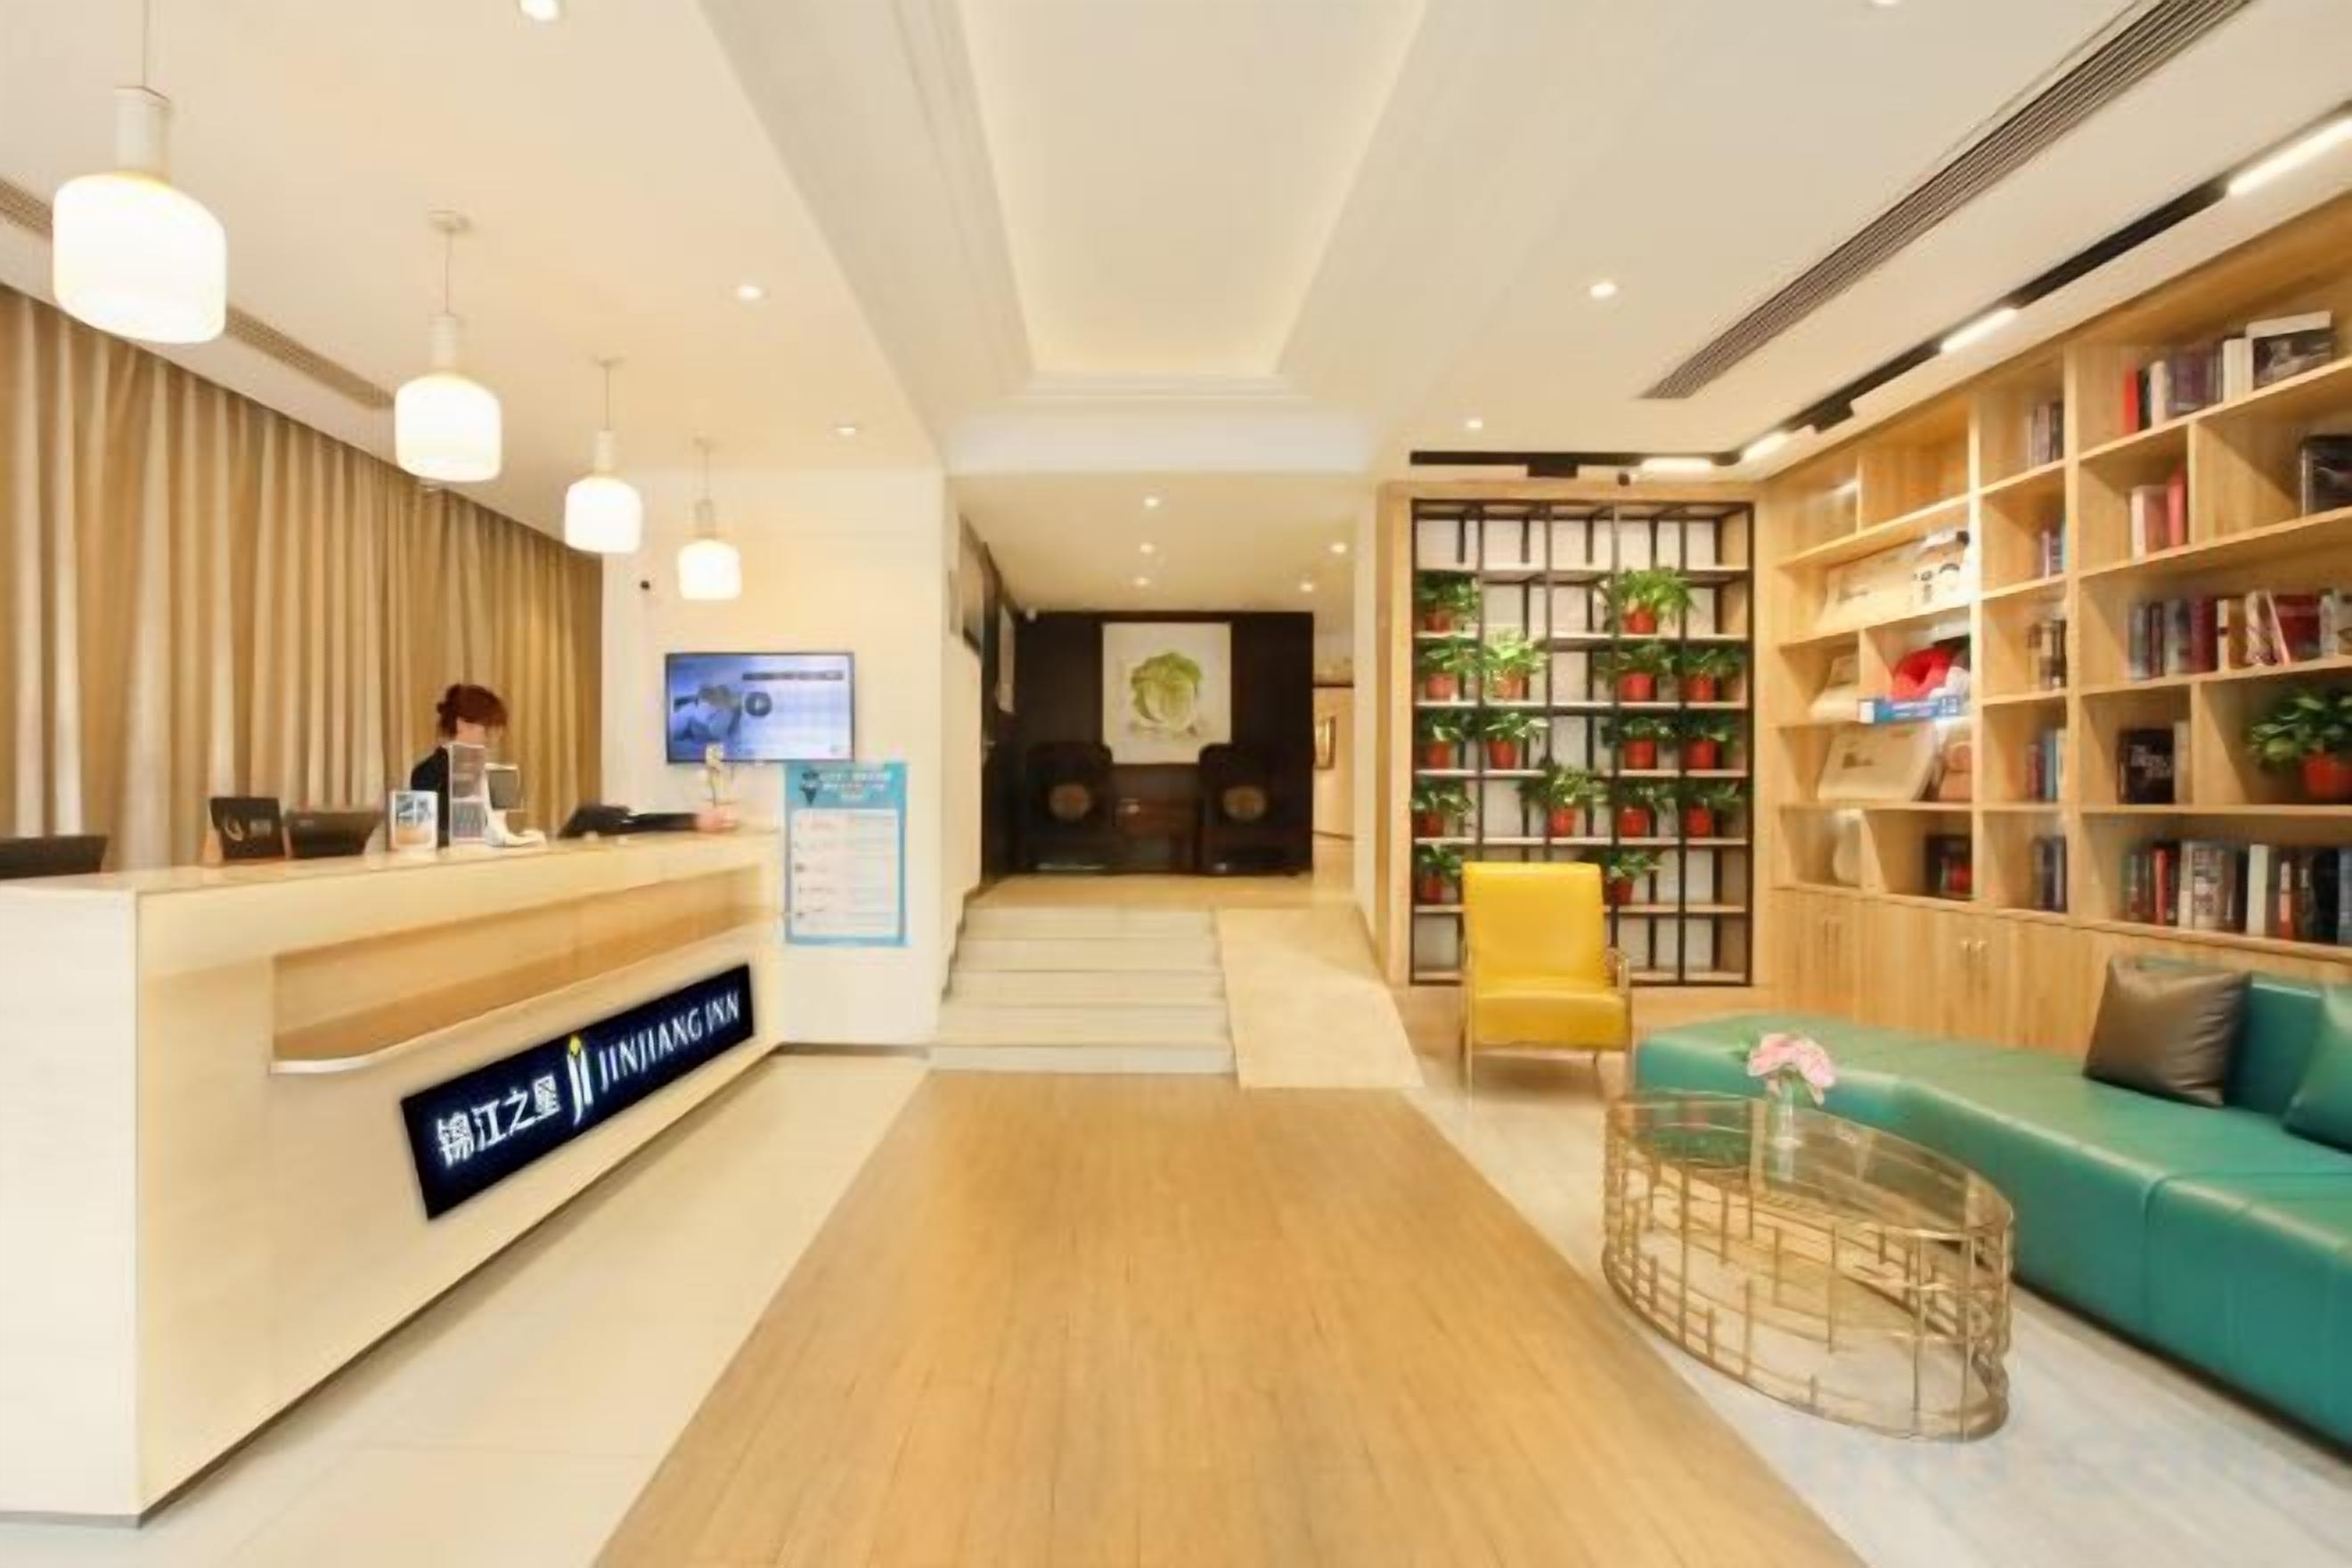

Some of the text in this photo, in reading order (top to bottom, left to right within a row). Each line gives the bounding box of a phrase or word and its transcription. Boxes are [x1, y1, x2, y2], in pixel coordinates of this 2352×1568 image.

[599, 992, 739, 1092] JINJIANG INN
[437, 1074, 559, 1165] 锦江之星
